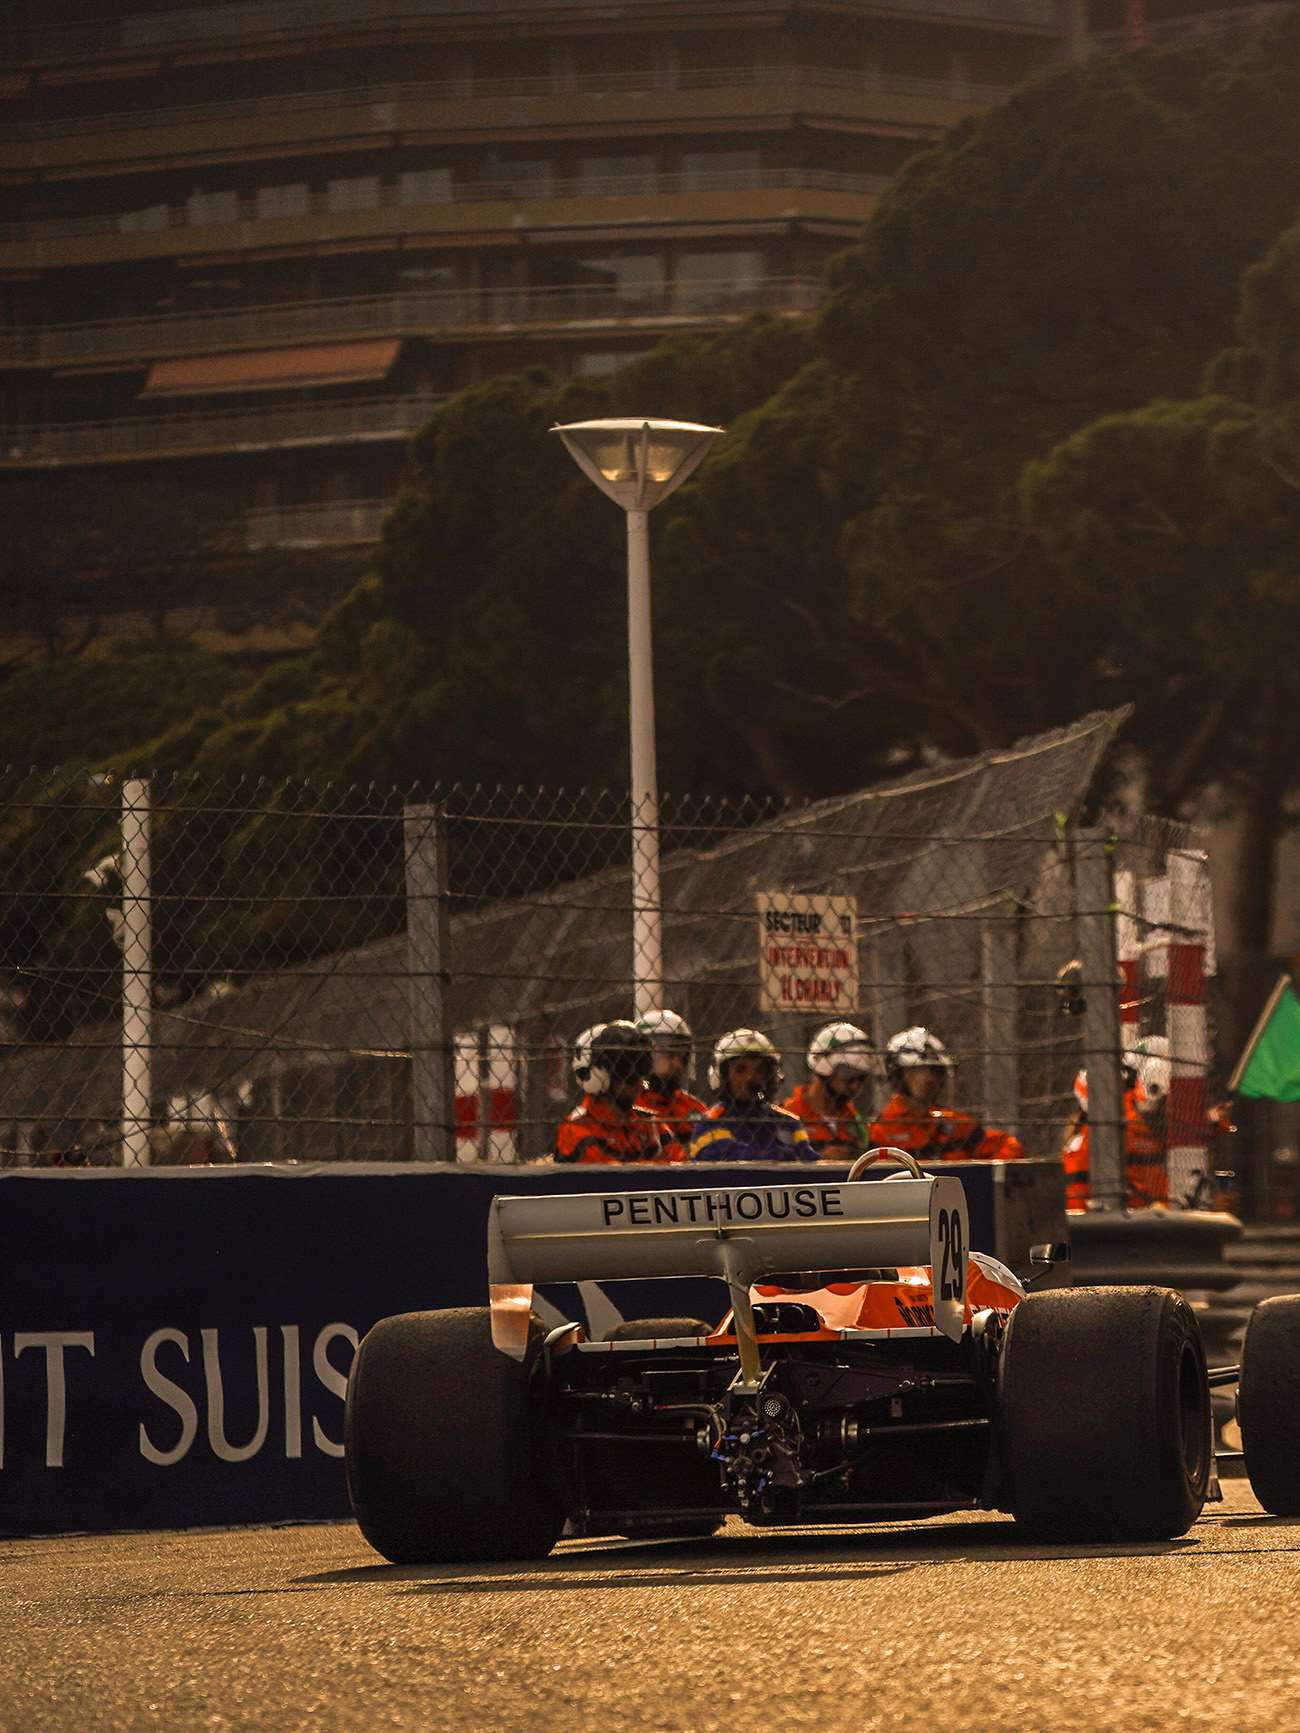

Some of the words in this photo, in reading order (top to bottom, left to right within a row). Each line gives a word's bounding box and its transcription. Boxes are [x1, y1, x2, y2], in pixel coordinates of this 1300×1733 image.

[766, 910, 822, 933] SECTEUR
[602, 1188, 845, 1226] PENTHOUSE
[938, 1208, 963, 1302] 29
[139, 1322, 359, 1466] SUIS
